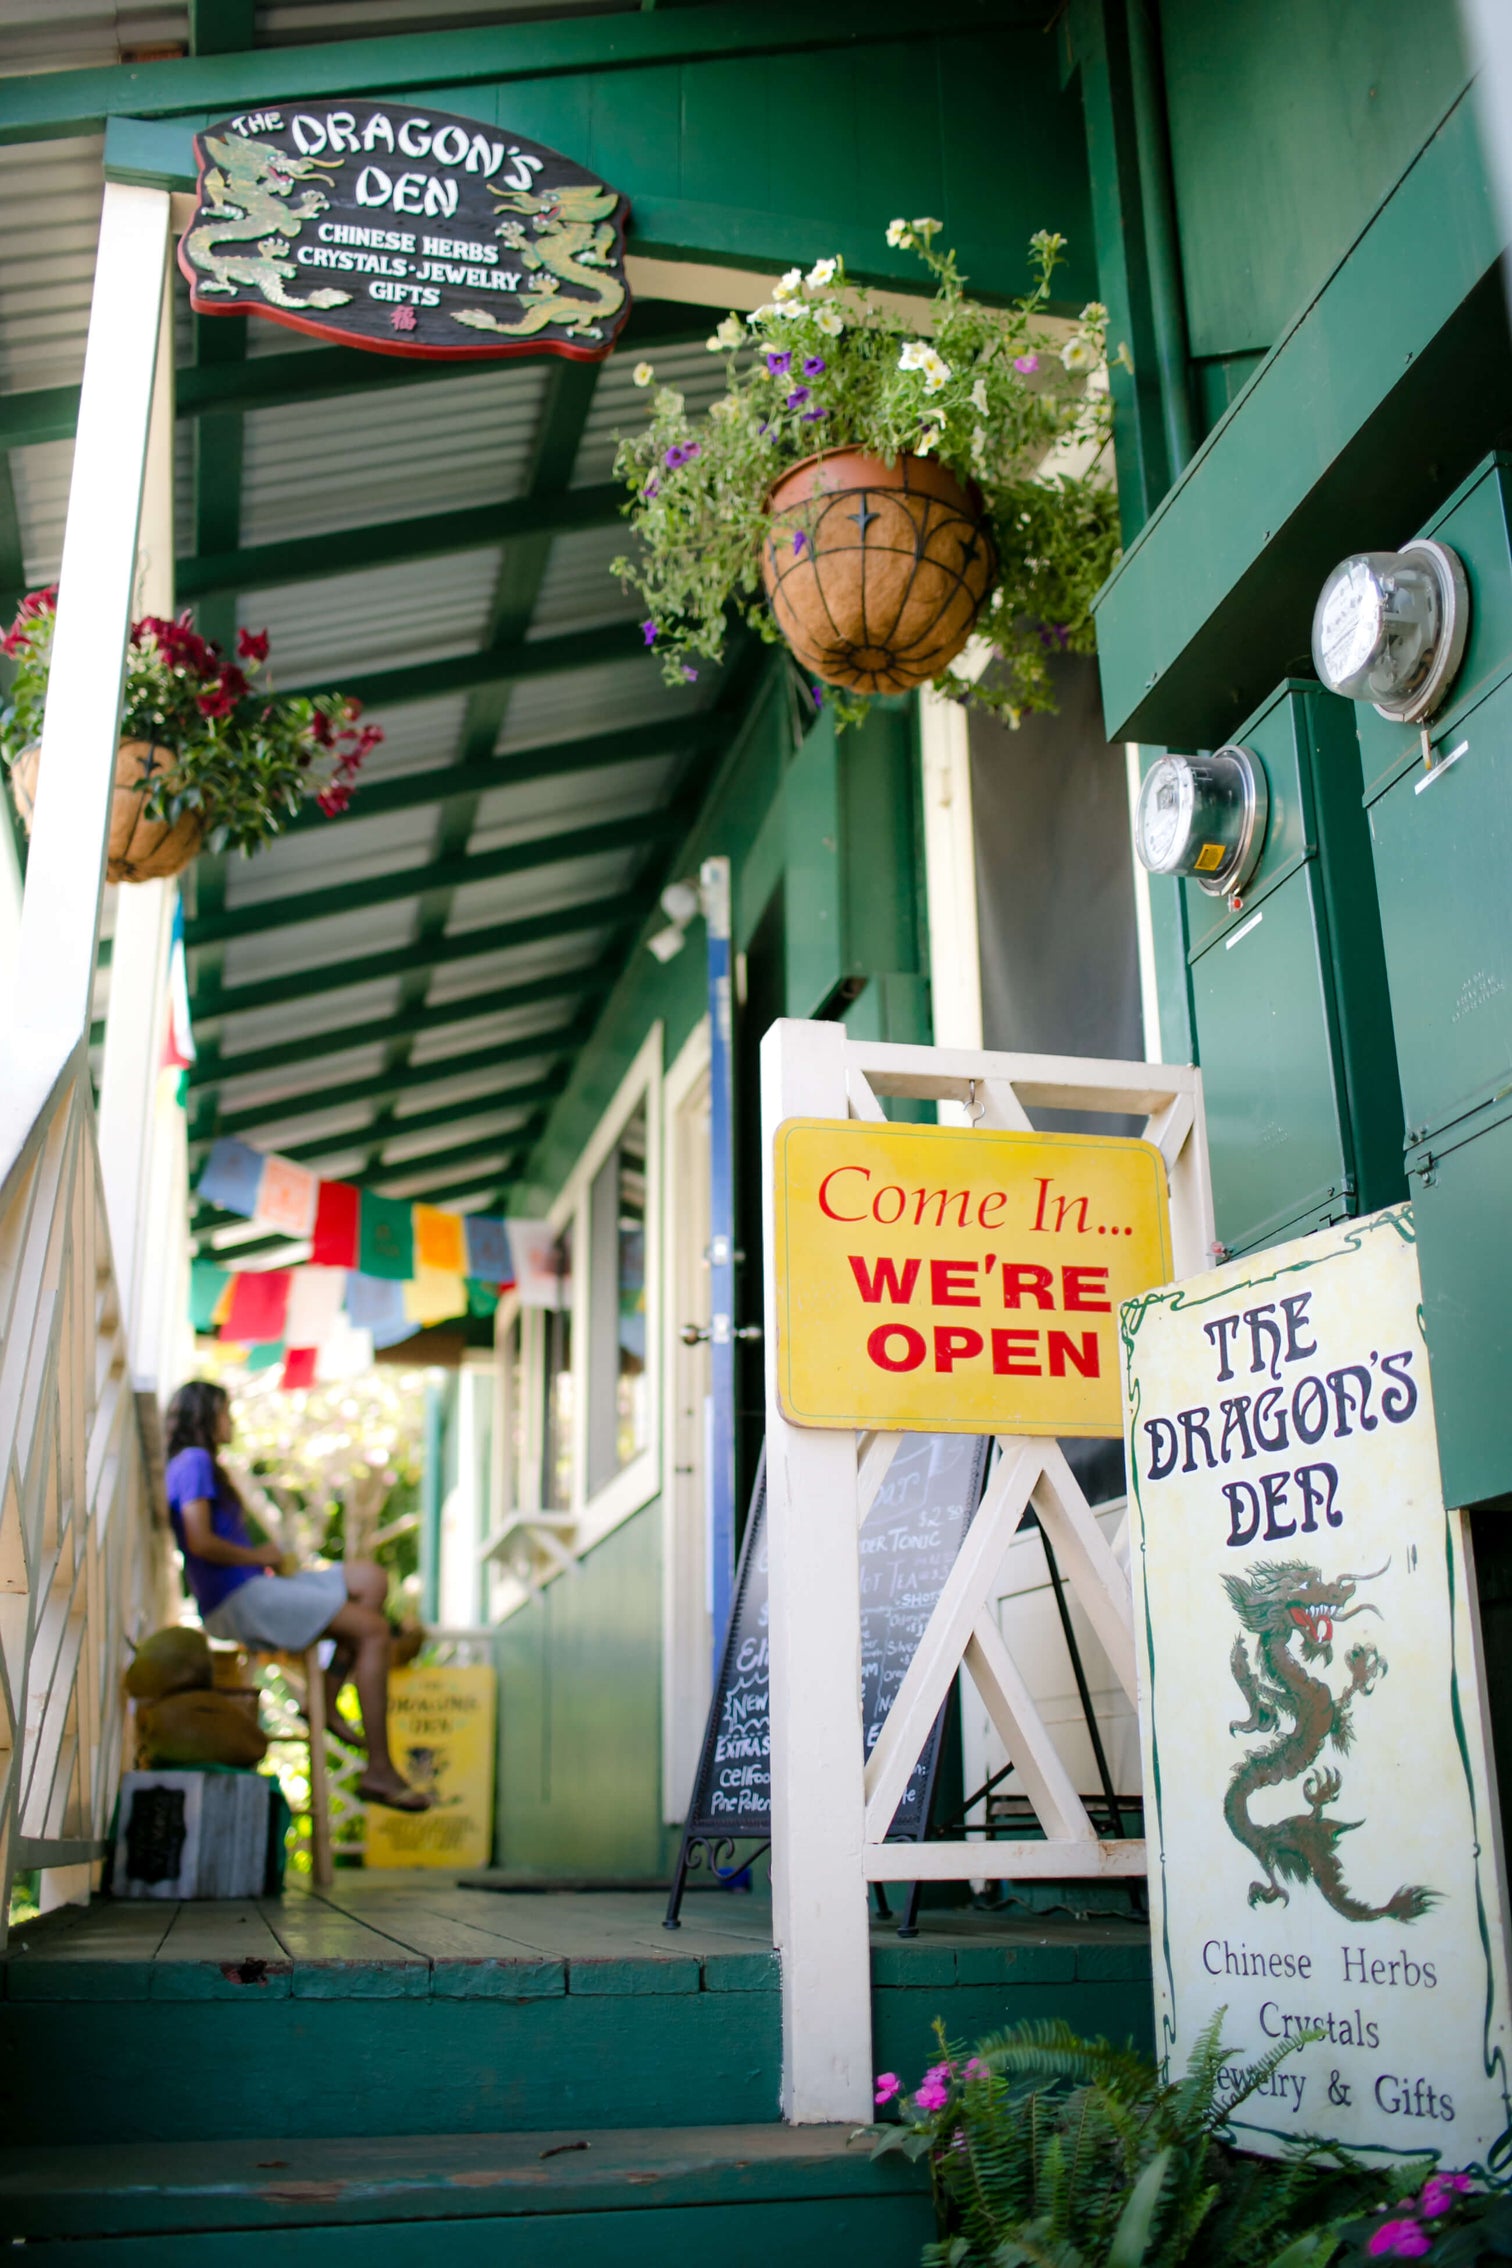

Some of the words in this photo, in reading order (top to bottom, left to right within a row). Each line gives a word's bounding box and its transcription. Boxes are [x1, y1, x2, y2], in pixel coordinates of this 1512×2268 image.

[231, 111, 285, 137] THE
[291, 111, 544, 191] DRAGON'S
[355, 166, 459, 218] DEN
[317, 223, 416, 254] CHINESE
[421, 236, 499, 266] HERBS
[368, 281, 441, 308] GIFTS
[818, 1166, 1008, 1230] Come
[1028, 1177, 1133, 1237] In...
[847, 1253, 1112, 1313] WE'RE
[866, 1323, 1101, 1379] OPEN
[1203, 1291, 1318, 1382] THE
[1143, 1350, 1418, 1481] DRAGON'S
[1221, 1462, 1344, 1547] DEN
[733, 1692, 769, 1724] NEW
[1202, 1939, 1312, 1979] Chinese
[1341, 1946, 1438, 1989] Herbs
[1259, 2001, 1380, 2053] Crystals
[1327, 2068, 1352, 2107] &
[1374, 2073, 1456, 2122] Gifts
